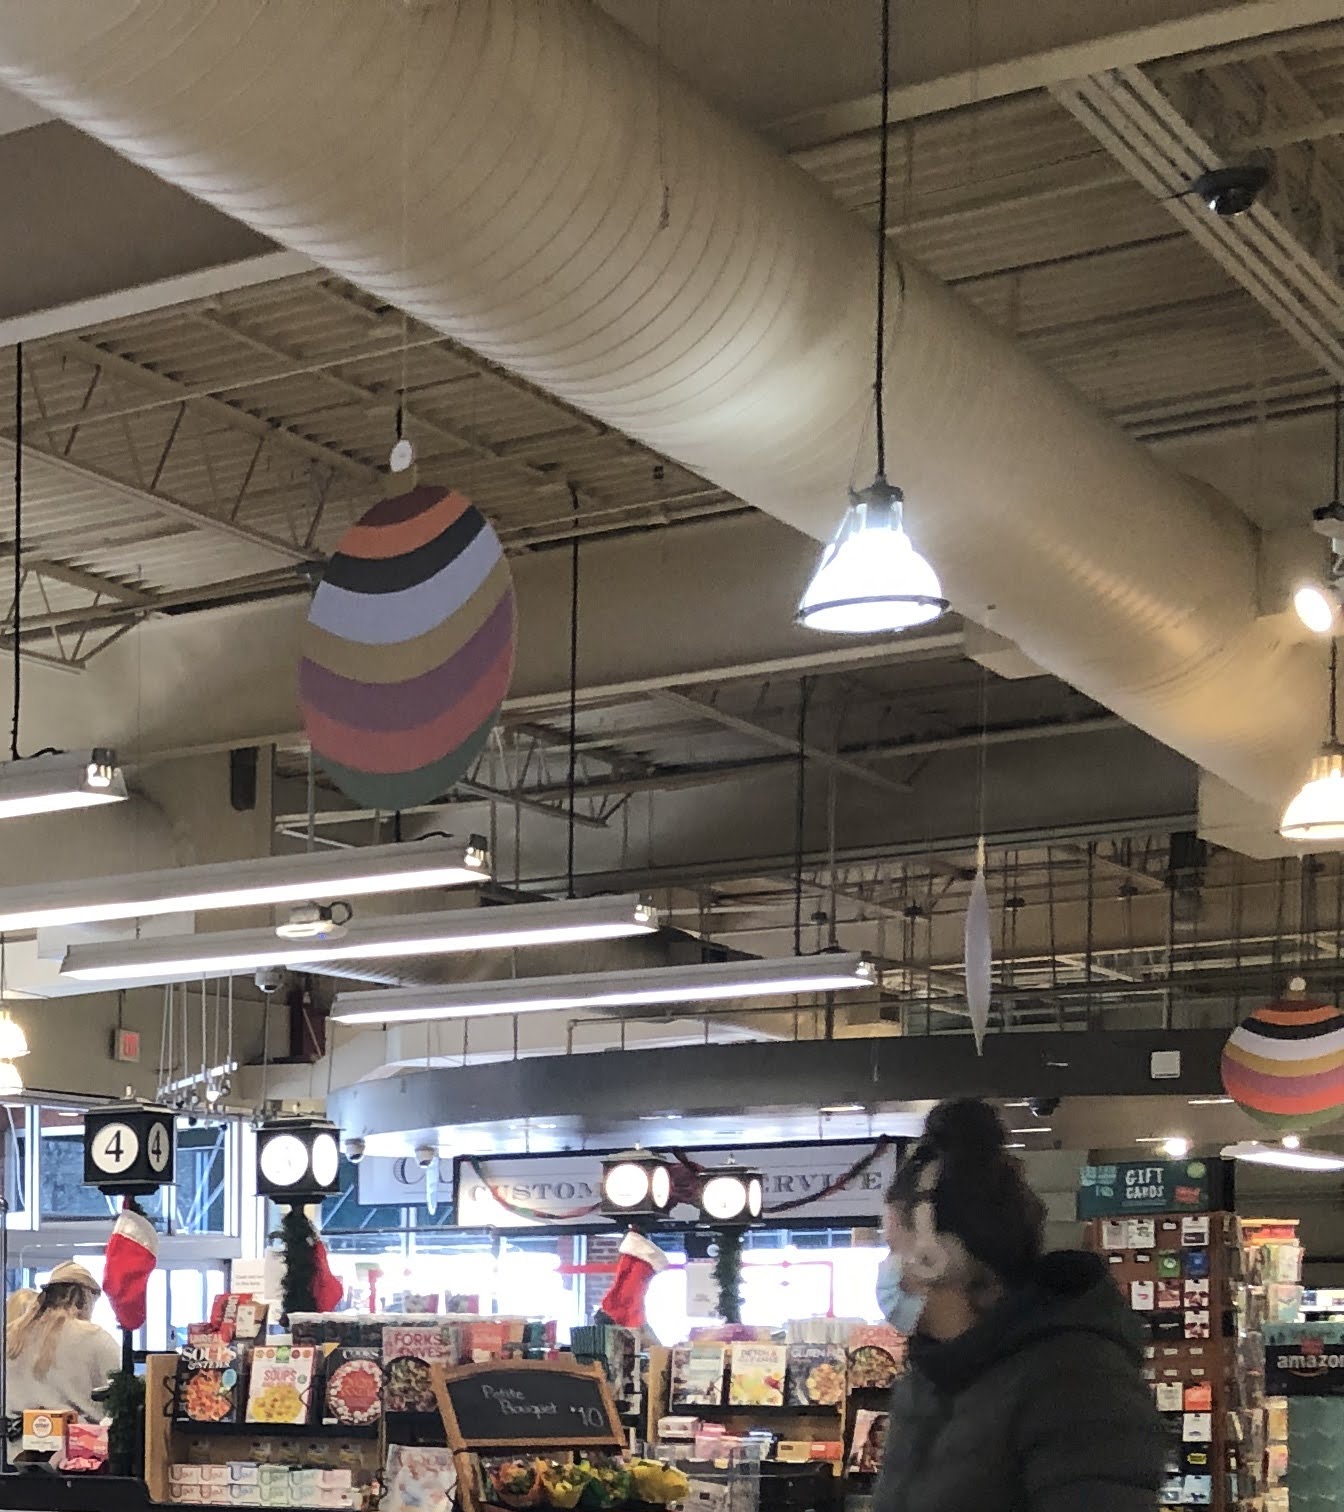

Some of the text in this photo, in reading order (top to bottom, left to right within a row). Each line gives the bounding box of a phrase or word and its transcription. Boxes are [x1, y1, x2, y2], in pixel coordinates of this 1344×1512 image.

[104, 1129, 125, 1163] 4
[151, 1129, 162, 1163] 4
[1125, 1167, 1164, 1186] GIFT
[1126, 1185, 1164, 1199] CARDS
